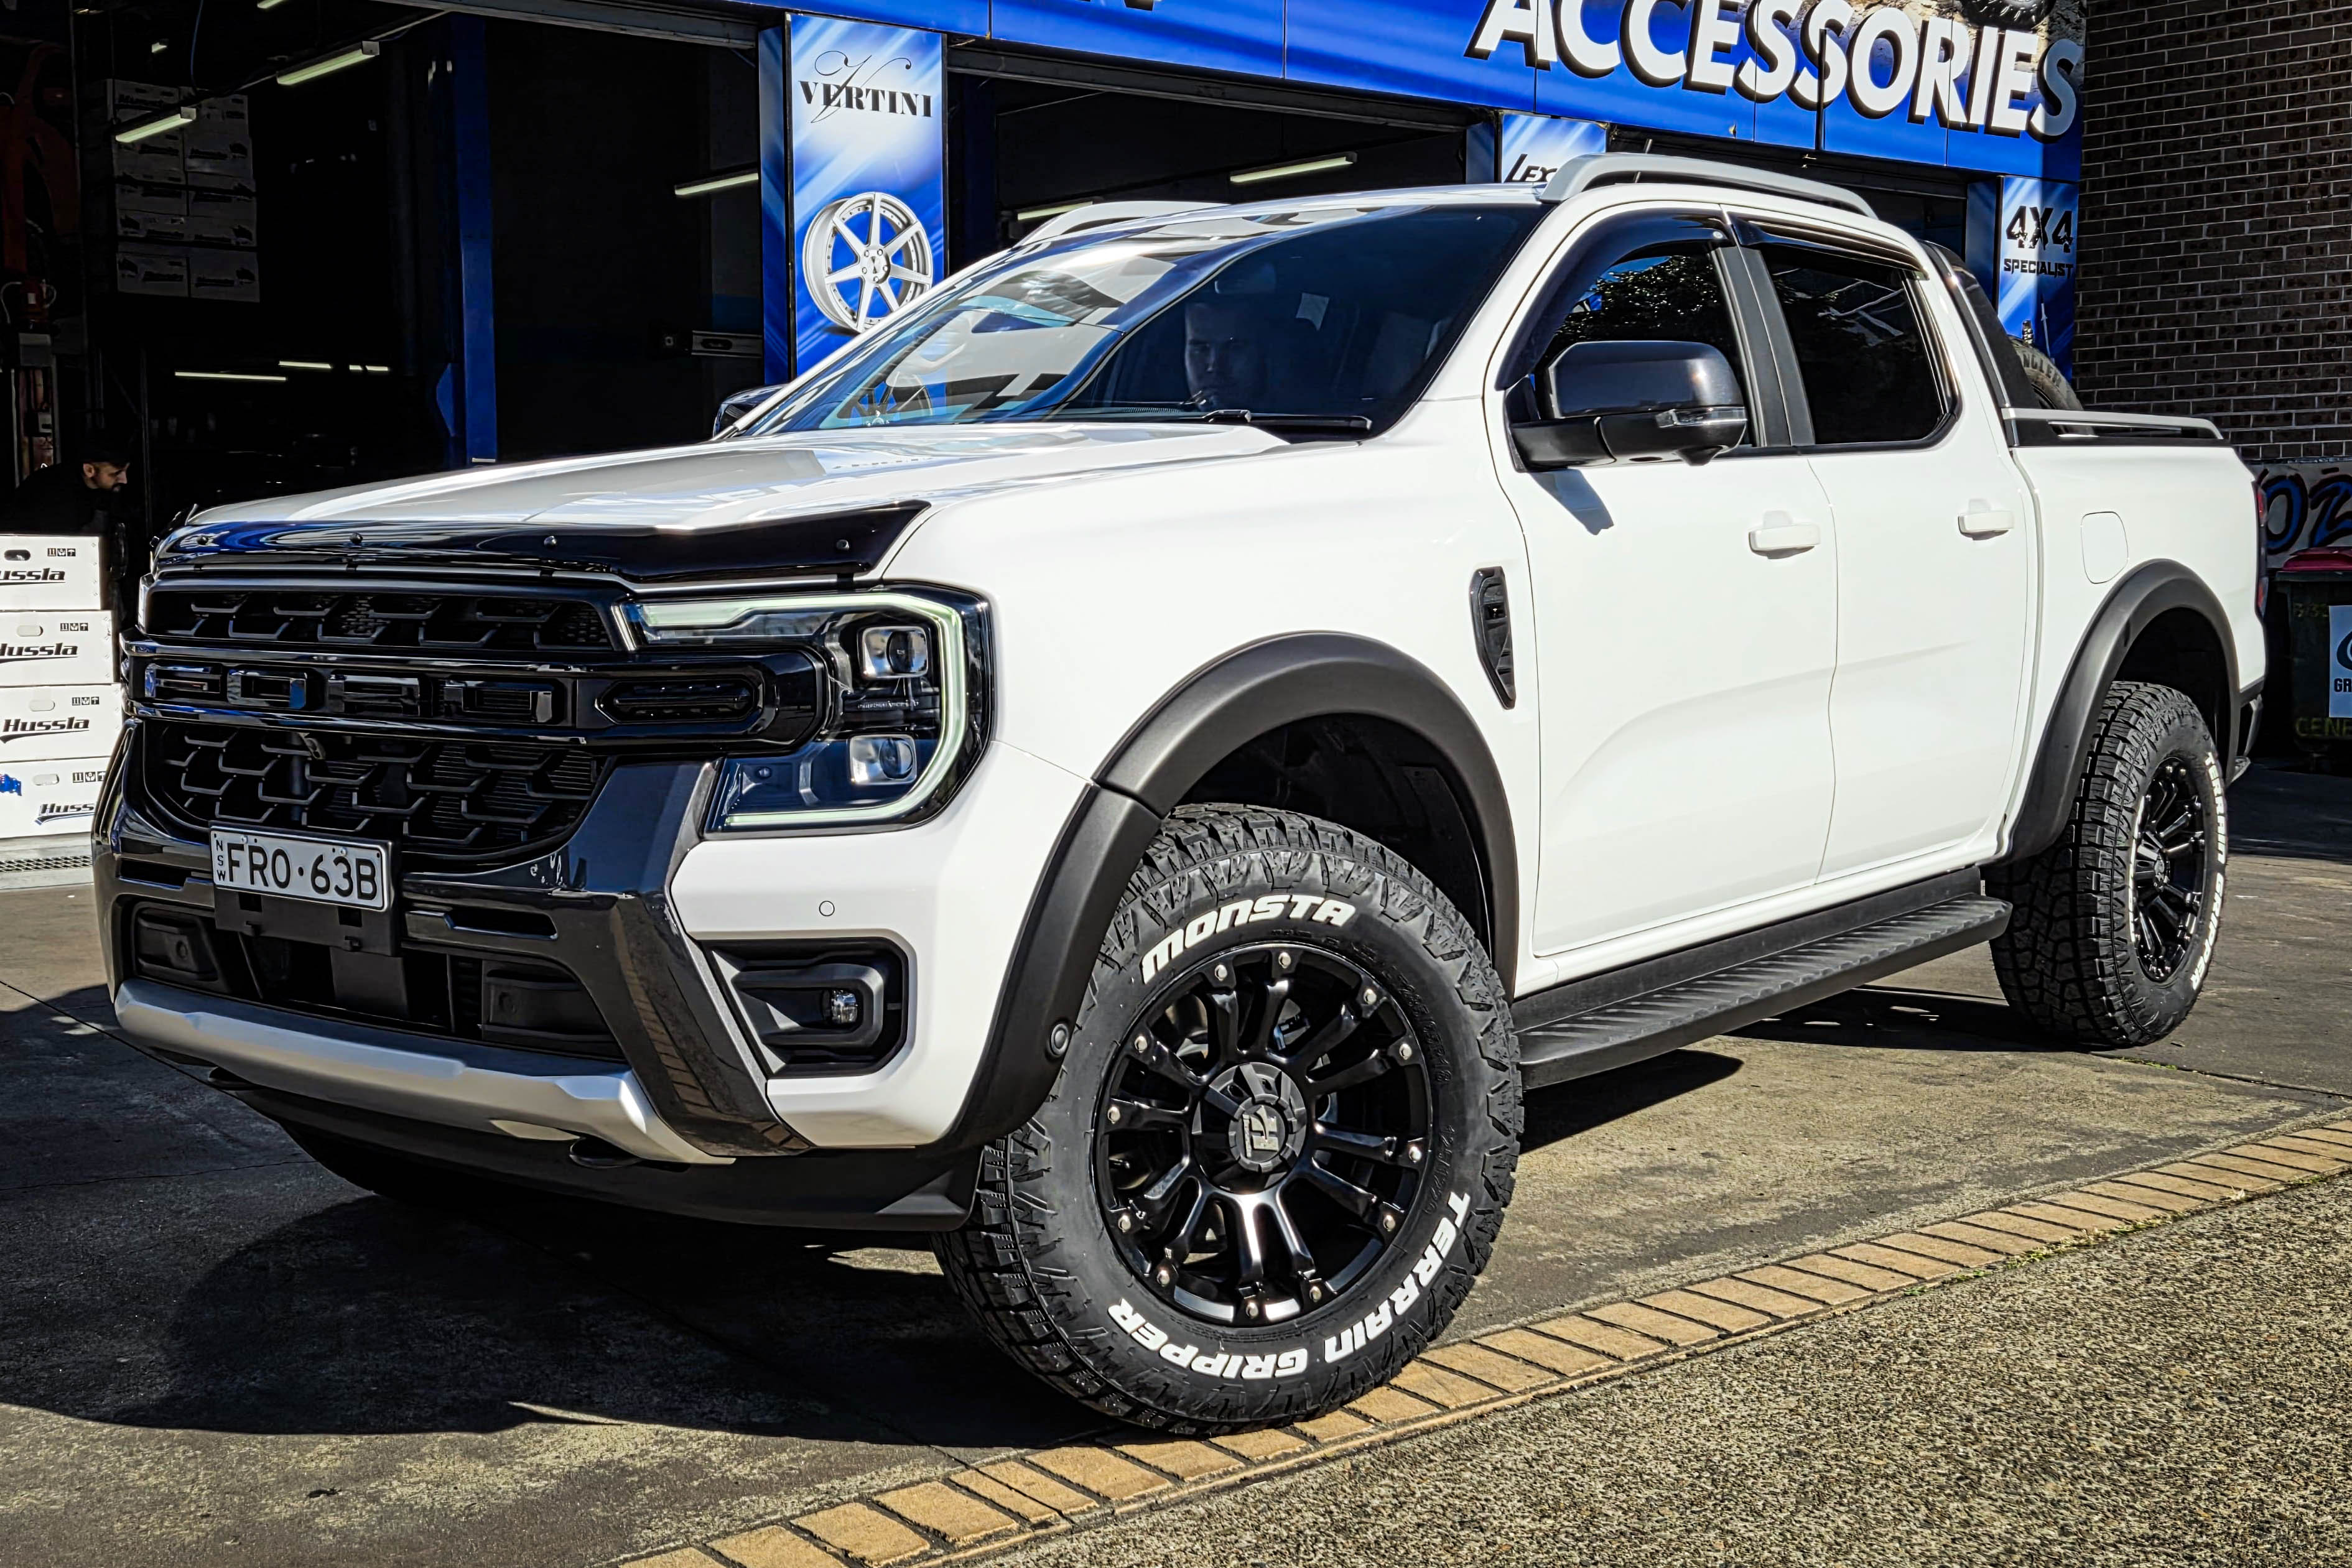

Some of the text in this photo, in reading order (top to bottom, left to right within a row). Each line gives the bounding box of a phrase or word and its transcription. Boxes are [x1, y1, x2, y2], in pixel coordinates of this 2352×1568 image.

[1469, 0, 2083, 137] ACCESSORIES
[799, 80, 933, 118] VERTINI
[1504, 154, 1558, 183] LEX
[2006, 205, 2073, 253] 4X4
[2004, 258, 2074, 279] SPECIALIST
[2022, 353, 2062, 387] NGLER
[0, 567, 65, 581] ussla
[2, 717, 90, 732] Hussla
[39, 803, 95, 816] Huss
[1141, 894, 1356, 985] MONSTA
[1107, 1191, 1471, 1380] TERRAIN GRIPPER
